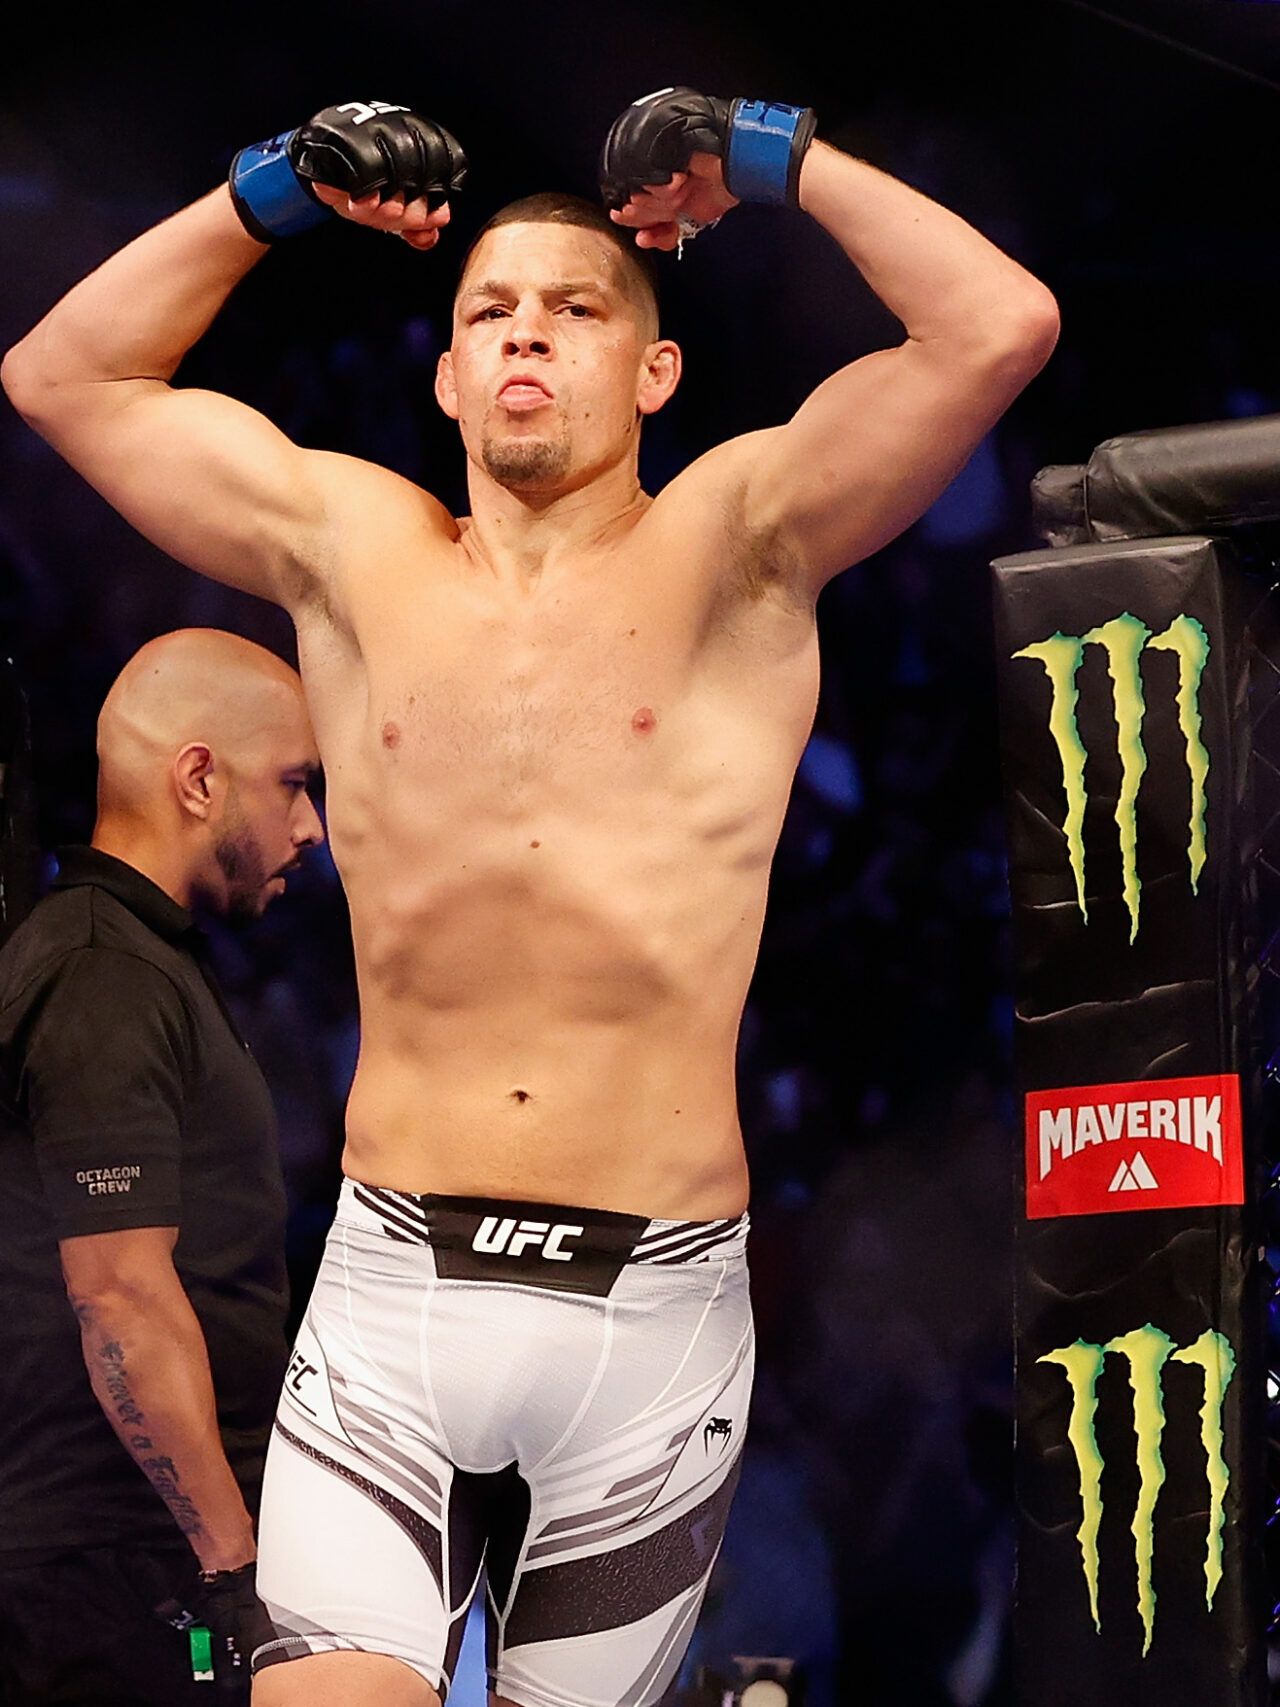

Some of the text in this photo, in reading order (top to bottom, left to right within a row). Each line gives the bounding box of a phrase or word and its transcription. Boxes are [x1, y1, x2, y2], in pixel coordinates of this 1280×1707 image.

[1039, 1095, 1223, 1182] MAVERIK
[76, 1166, 141, 1184] OCTAGON
[88, 1180, 131, 1196] CREW
[472, 1216, 584, 1261] UFC
